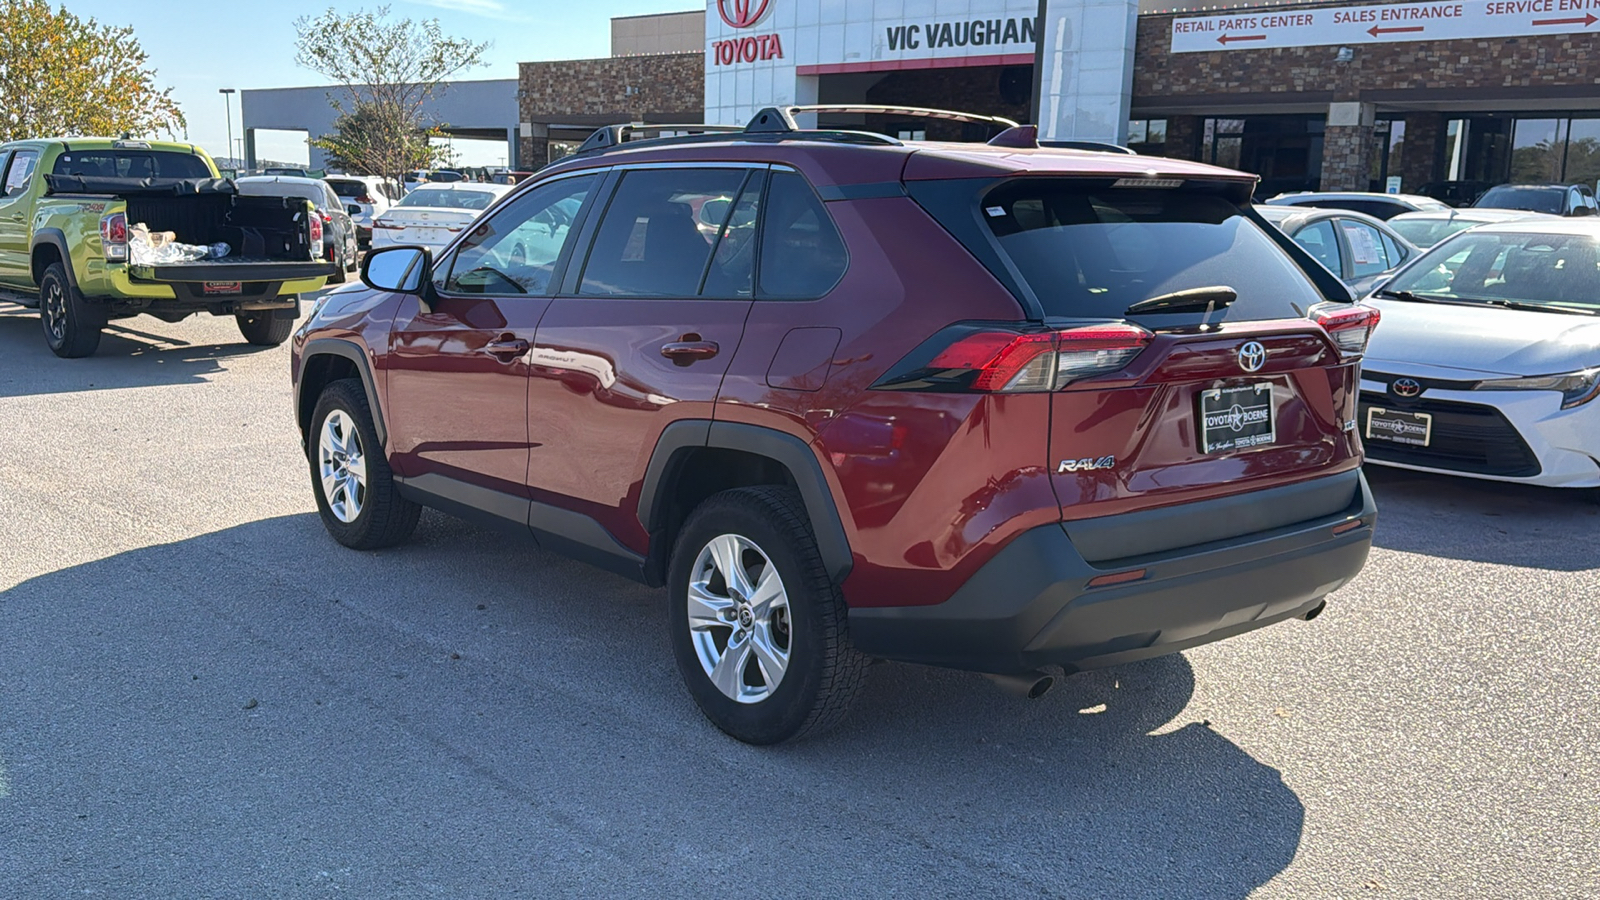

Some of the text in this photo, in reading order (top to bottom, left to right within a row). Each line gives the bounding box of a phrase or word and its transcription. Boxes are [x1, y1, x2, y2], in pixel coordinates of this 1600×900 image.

[1333, 4, 1463, 24] SALES ENTRANCE
[1485, 0, 1553, 15] SERVICE
[1174, 14, 1313, 33] RETAIL PARTS CENTER
[887, 17, 1038, 51] VIC VAUGHAN
[712, 33, 783, 66] TOYOTA
[1205, 409, 1268, 427] TOYOTA BOERNE
[1058, 455, 1115, 473] RAV4
